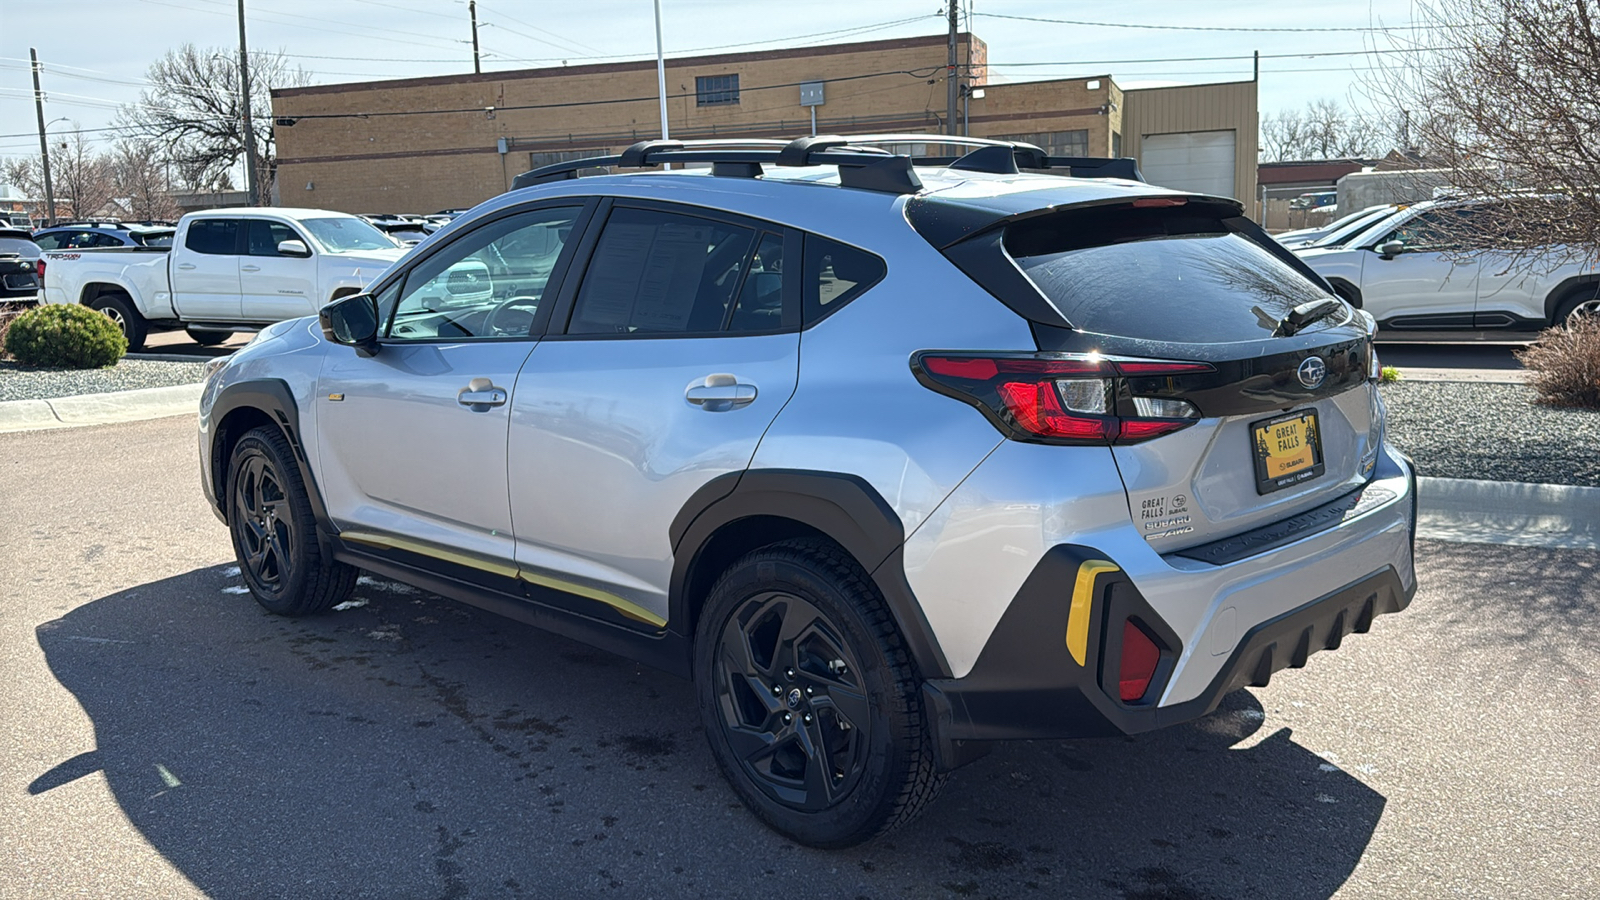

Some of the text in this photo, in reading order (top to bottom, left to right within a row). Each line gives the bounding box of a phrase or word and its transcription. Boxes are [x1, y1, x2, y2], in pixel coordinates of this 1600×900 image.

[1276, 424, 1298, 439] GREAT
[1278, 436, 1300, 452] FALLS
[1286, 458, 1304, 468] SUBARU
[1142, 497, 1164, 509] GREAT
[1142, 507, 1164, 520] FALLS
[1168, 507, 1188, 515] SUBARU
[1145, 515, 1191, 530] SUBARU
[1164, 526, 1194, 538] AWD
